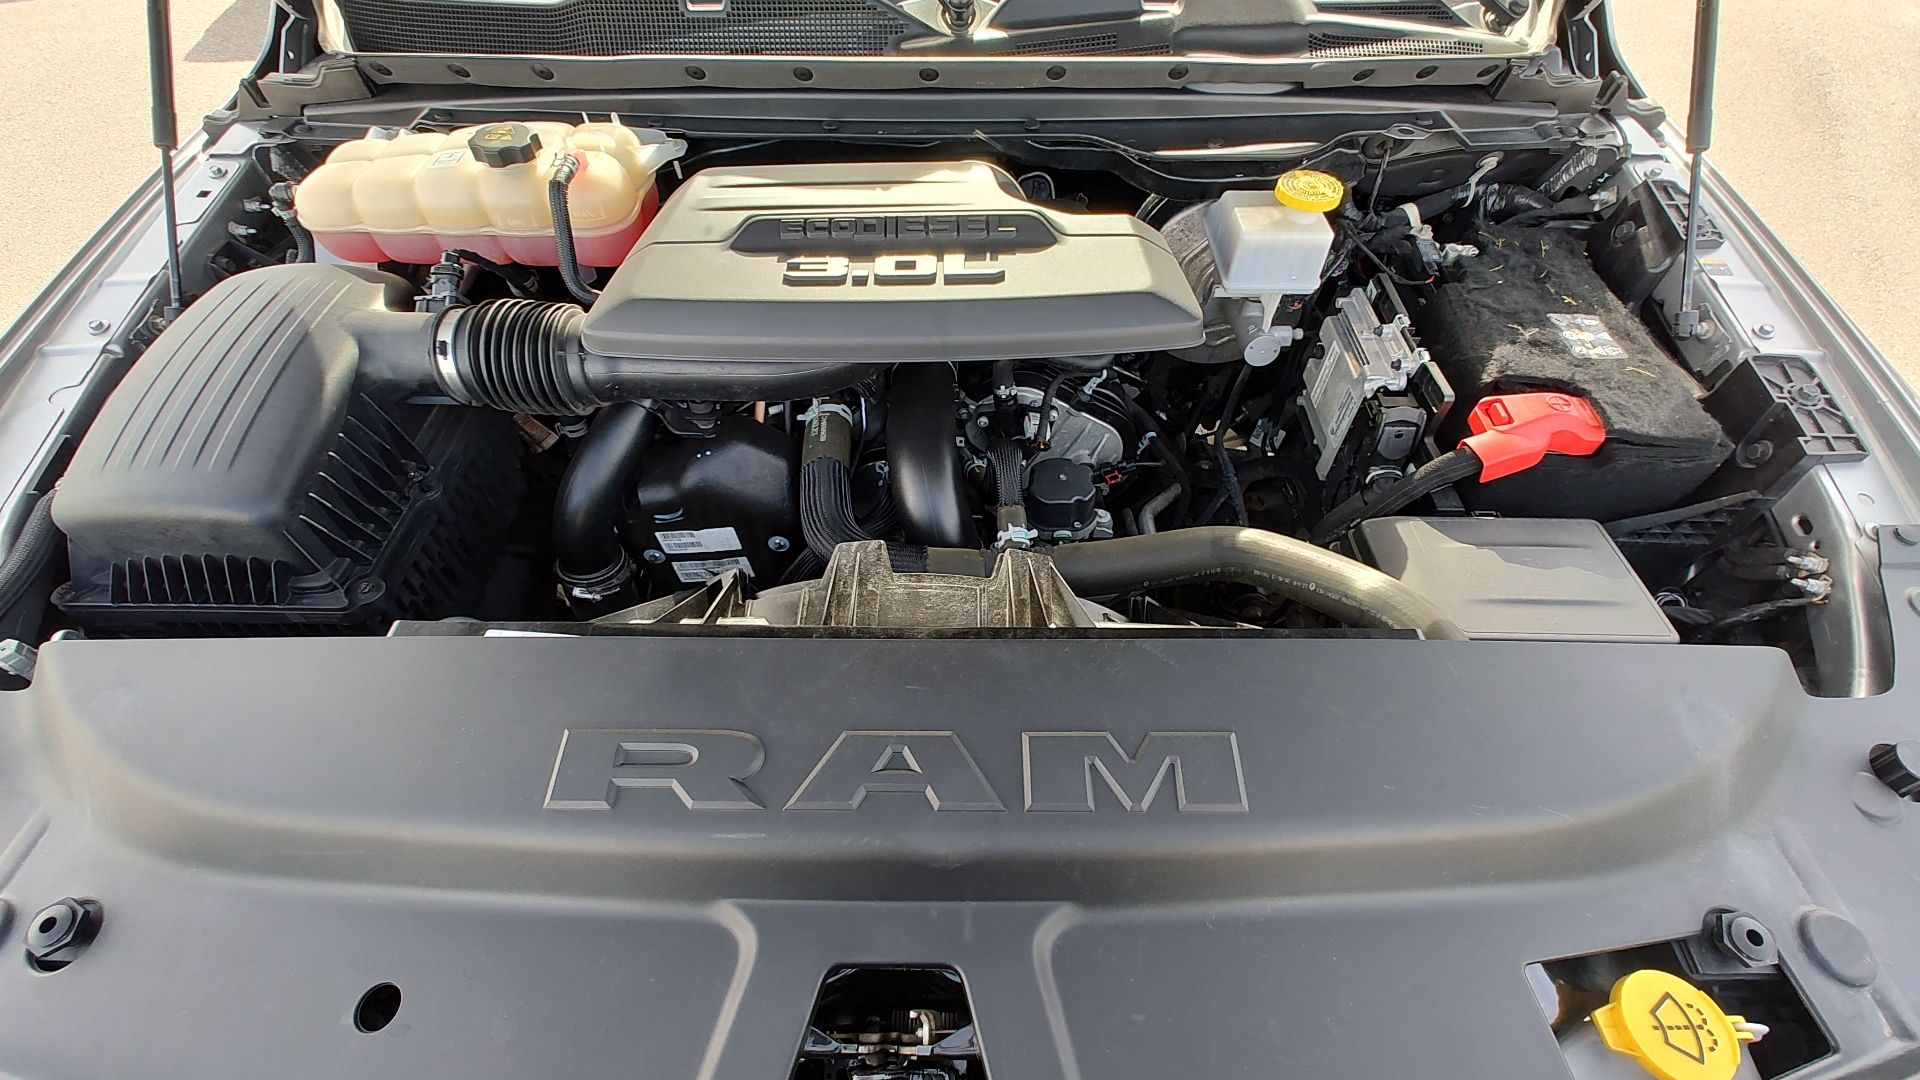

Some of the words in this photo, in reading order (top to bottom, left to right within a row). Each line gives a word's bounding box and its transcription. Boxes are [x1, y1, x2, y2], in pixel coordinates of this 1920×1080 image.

[780, 215, 1018, 241] ECODIESEL
[782, 253, 1006, 287] 3.0L
[542, 727, 1250, 813] RAM
